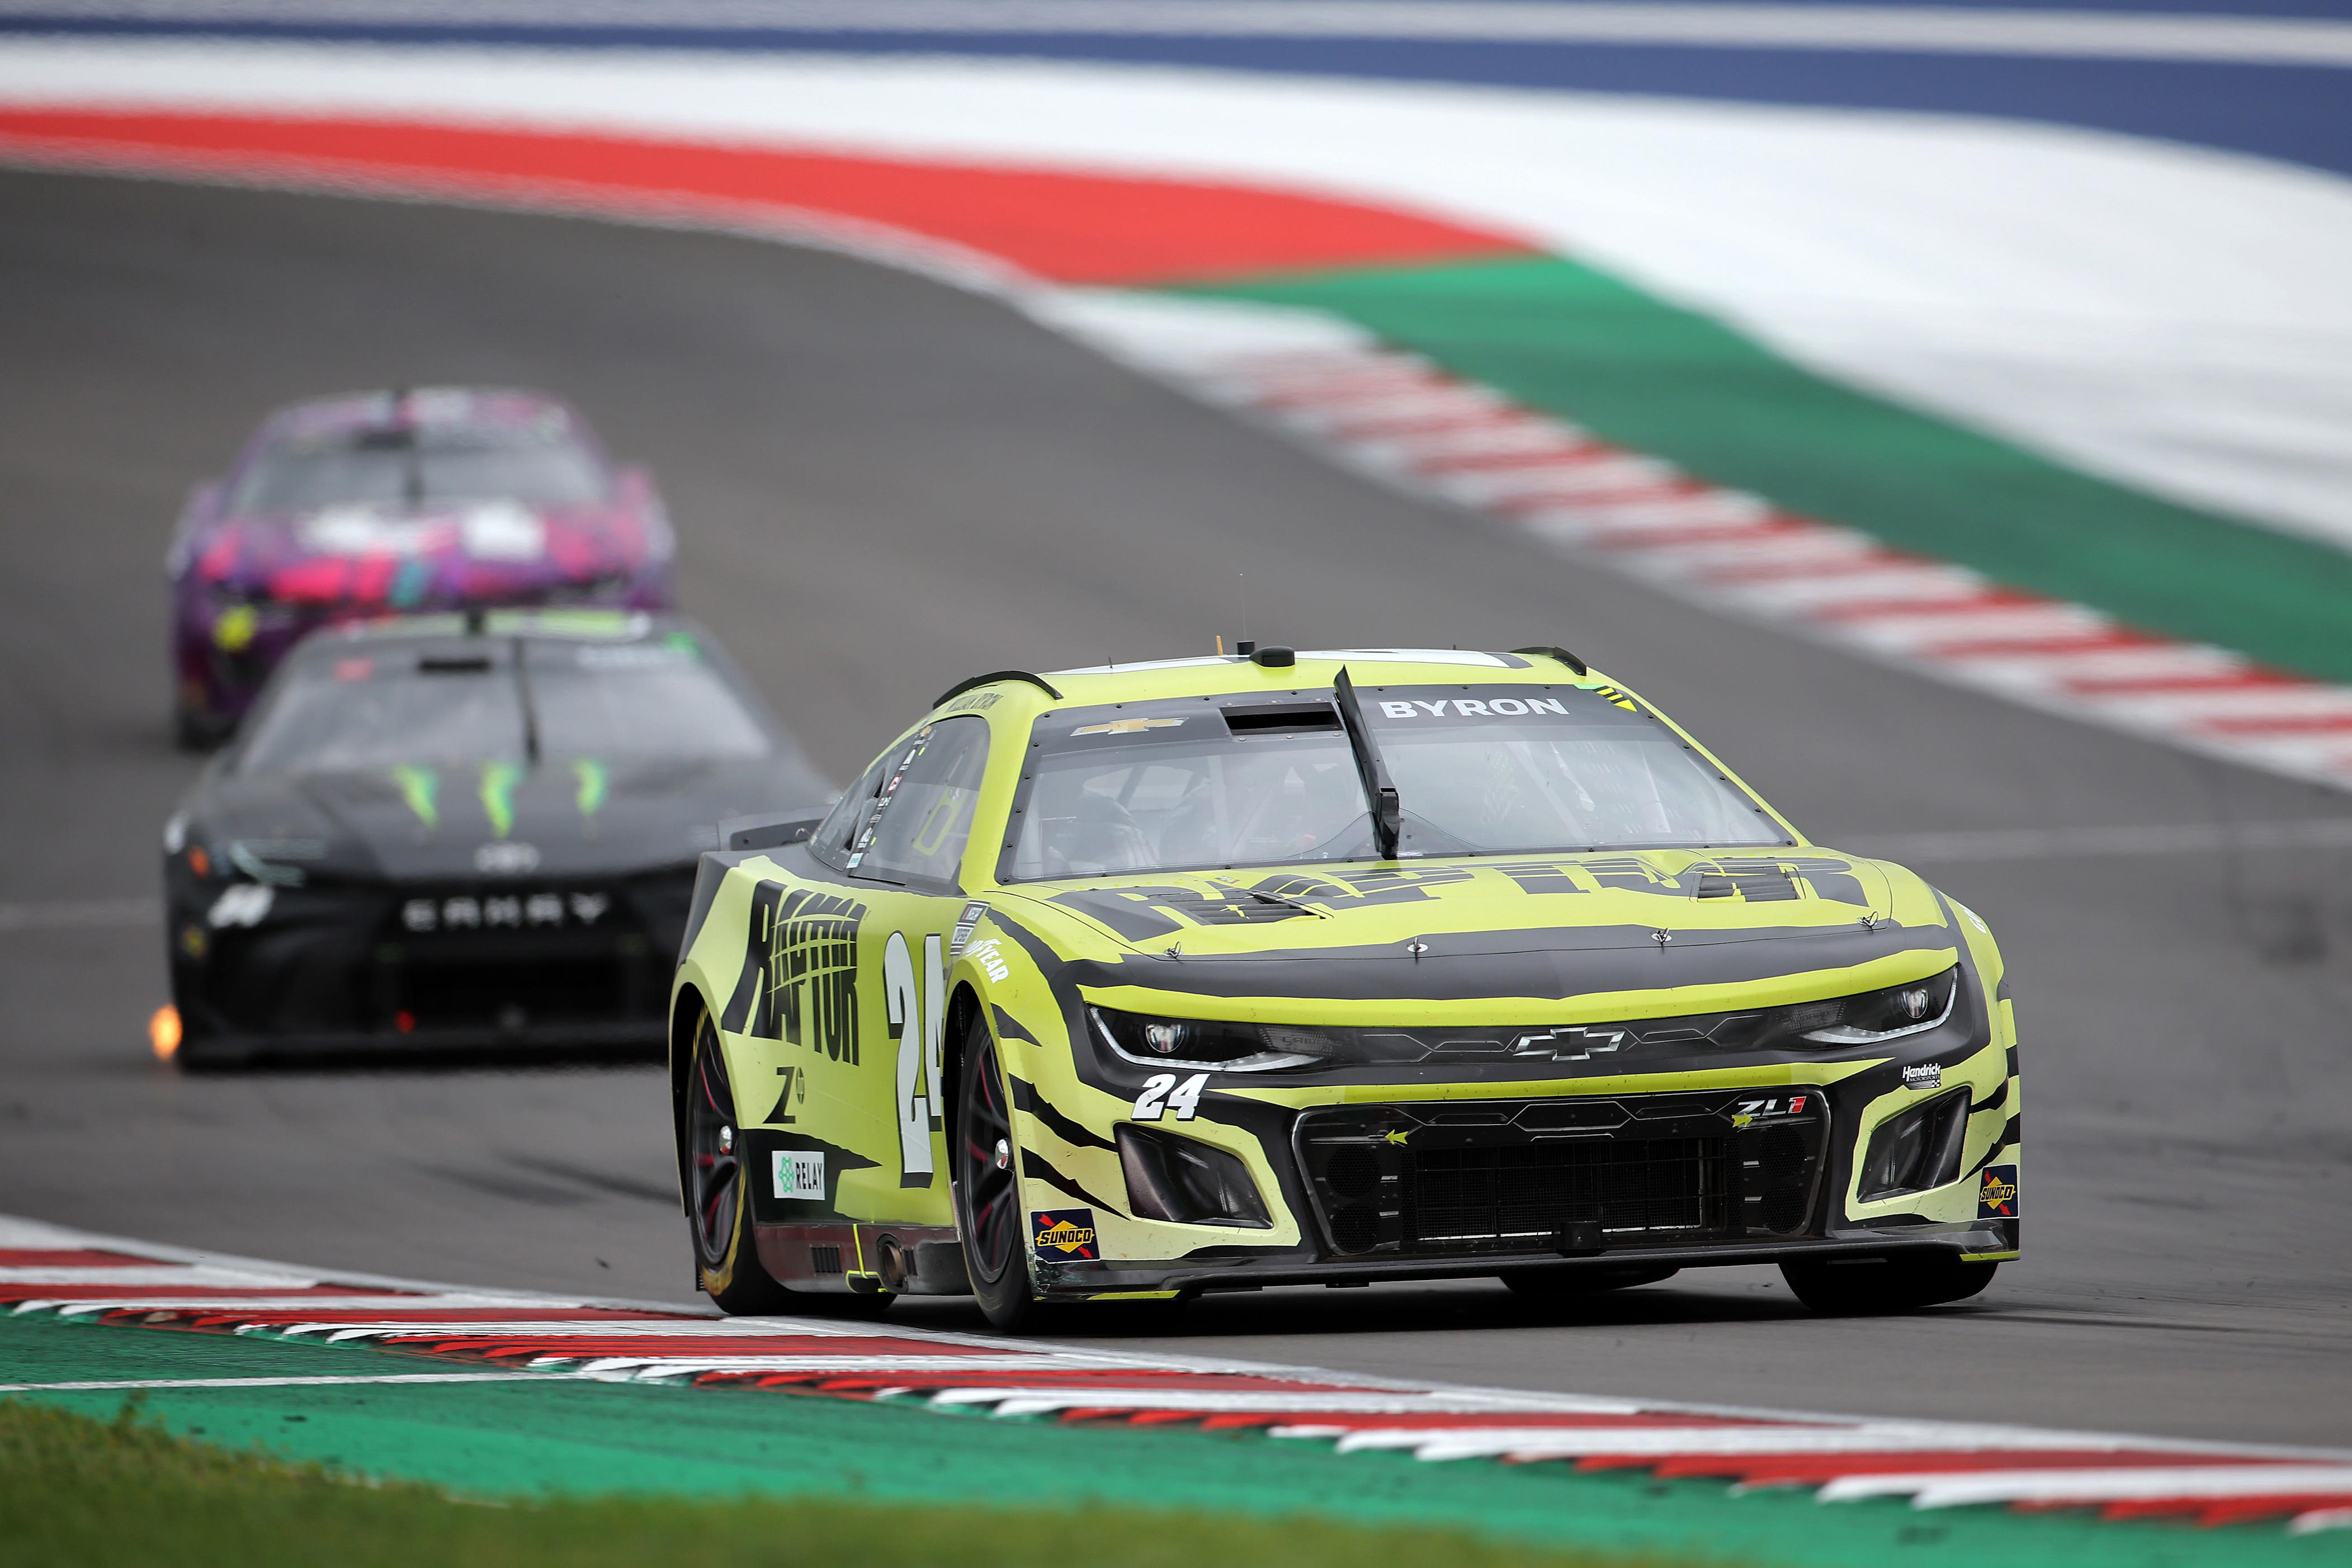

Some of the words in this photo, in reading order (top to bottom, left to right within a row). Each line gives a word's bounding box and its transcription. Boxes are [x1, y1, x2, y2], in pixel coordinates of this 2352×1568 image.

[1378, 698, 1570, 719] BYRON
[721, 879, 867, 1066] RAPTOR
[1902, 1062, 1941, 1082] Hendrick
[1131, 1073, 1211, 1122] 24
[1737, 1096, 1807, 1118] ZL1
[796, 1162, 823, 1190] RELAY
[1981, 1186, 2013, 1201] SUNOCO
[1039, 1229, 1090, 1245] SUNOCO
